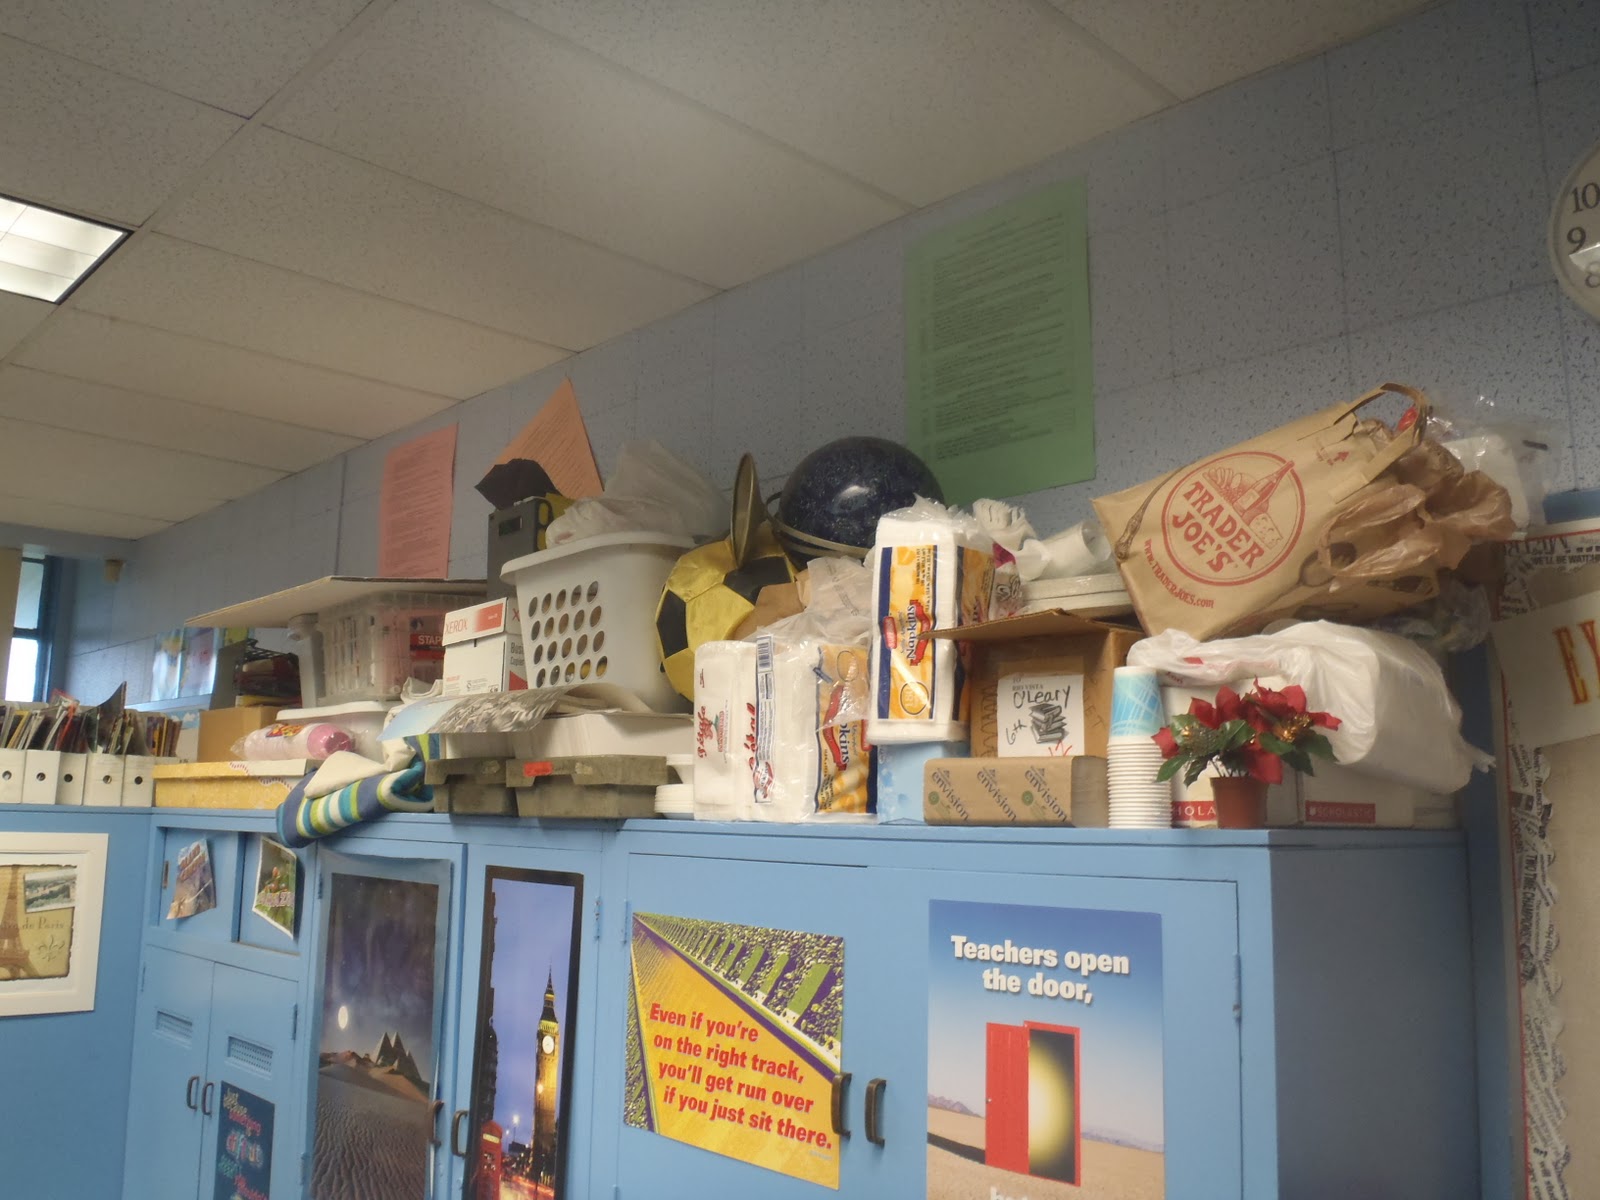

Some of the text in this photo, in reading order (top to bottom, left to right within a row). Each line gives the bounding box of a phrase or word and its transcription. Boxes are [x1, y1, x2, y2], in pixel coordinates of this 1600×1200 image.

[1572, 182, 1600, 214] 10
[1567, 226, 1586, 254] 9
[1172, 511, 1234, 573] JOE'S
[1183, 480, 1265, 570] TRADER
[1144, 538, 1215, 609] www.TRADERJOES.com
[445, 618, 468, 635] XEROX
[905, 604, 918, 661] Napkins
[931, 769, 970, 822] envision
[977, 769, 1017, 822] envision
[1024, 768, 1068, 823] envision
[38, 916, 65, 930] Paris
[951, 935, 1130, 976] Teachers open
[983, 968, 1093, 1004] the door,
[650, 1002, 759, 1043] Even if you're
[654, 1033, 805, 1084] on the right track,
[658, 1061, 814, 1114] you'll get run over
[663, 1086, 832, 1150] if you just sit there.
